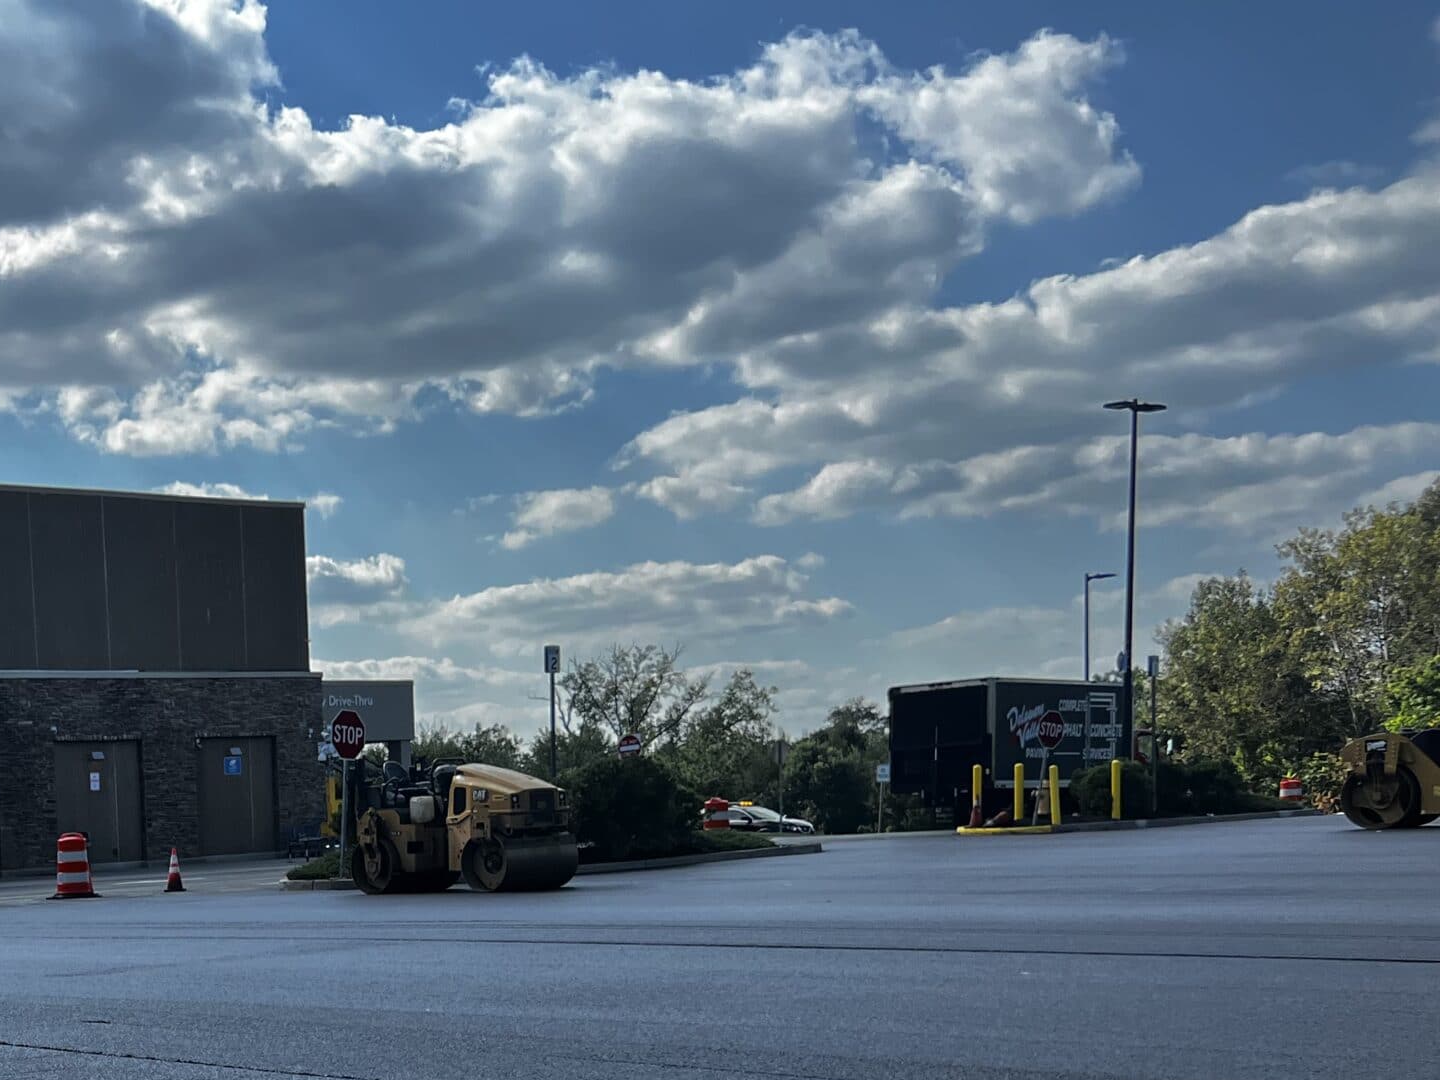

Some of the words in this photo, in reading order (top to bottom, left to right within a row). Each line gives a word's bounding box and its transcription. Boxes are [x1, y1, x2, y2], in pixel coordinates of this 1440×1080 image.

[551, 656, 558, 670] 2
[328, 695, 374, 707] Drive-Thru
[333, 724, 364, 745] STOP
[1040, 721, 1062, 738] STOP
[1063, 723, 1084, 737] PHALT
[472, 789, 486, 801] CAT
